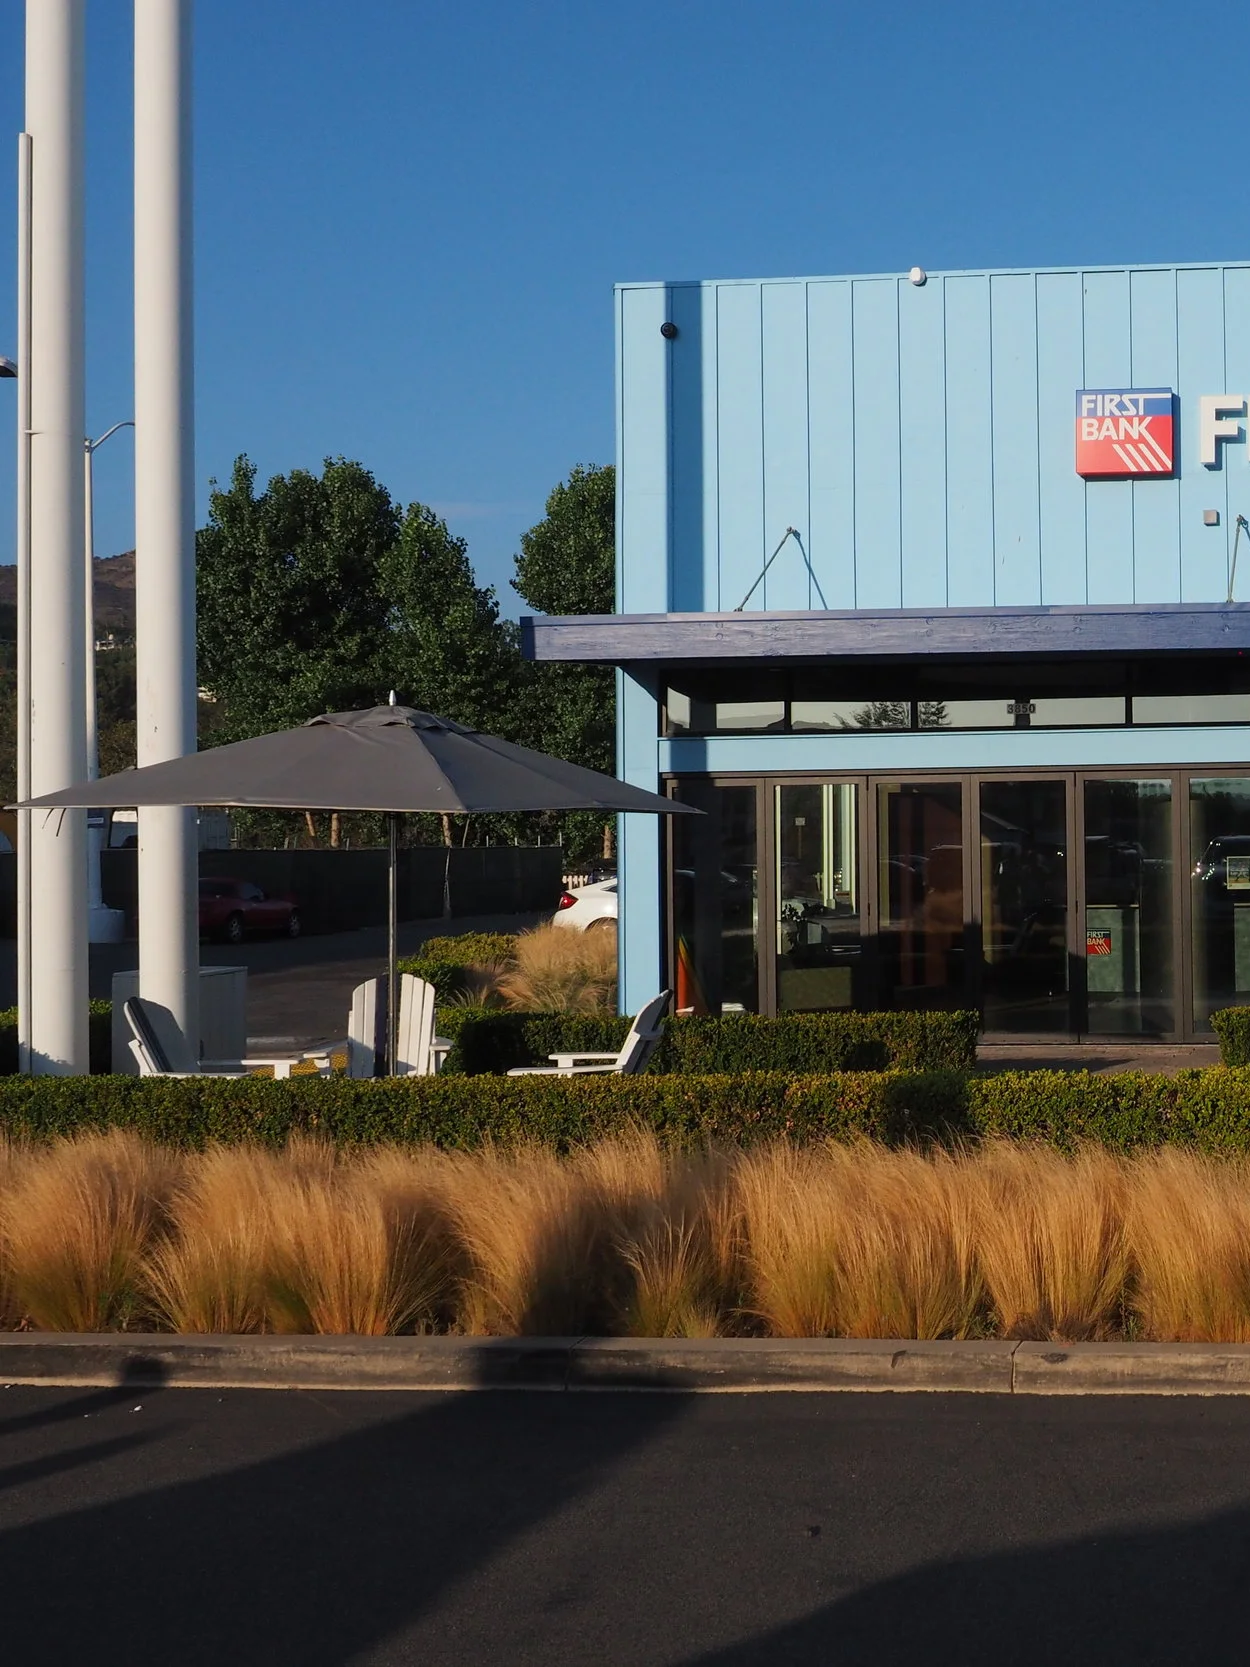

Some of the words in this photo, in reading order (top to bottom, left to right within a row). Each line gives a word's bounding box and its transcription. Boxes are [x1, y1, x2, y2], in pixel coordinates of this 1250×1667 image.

[1082, 393, 1171, 417] FIRST
[1082, 416, 1156, 442] BANK
[1007, 703, 1036, 714] 3850
